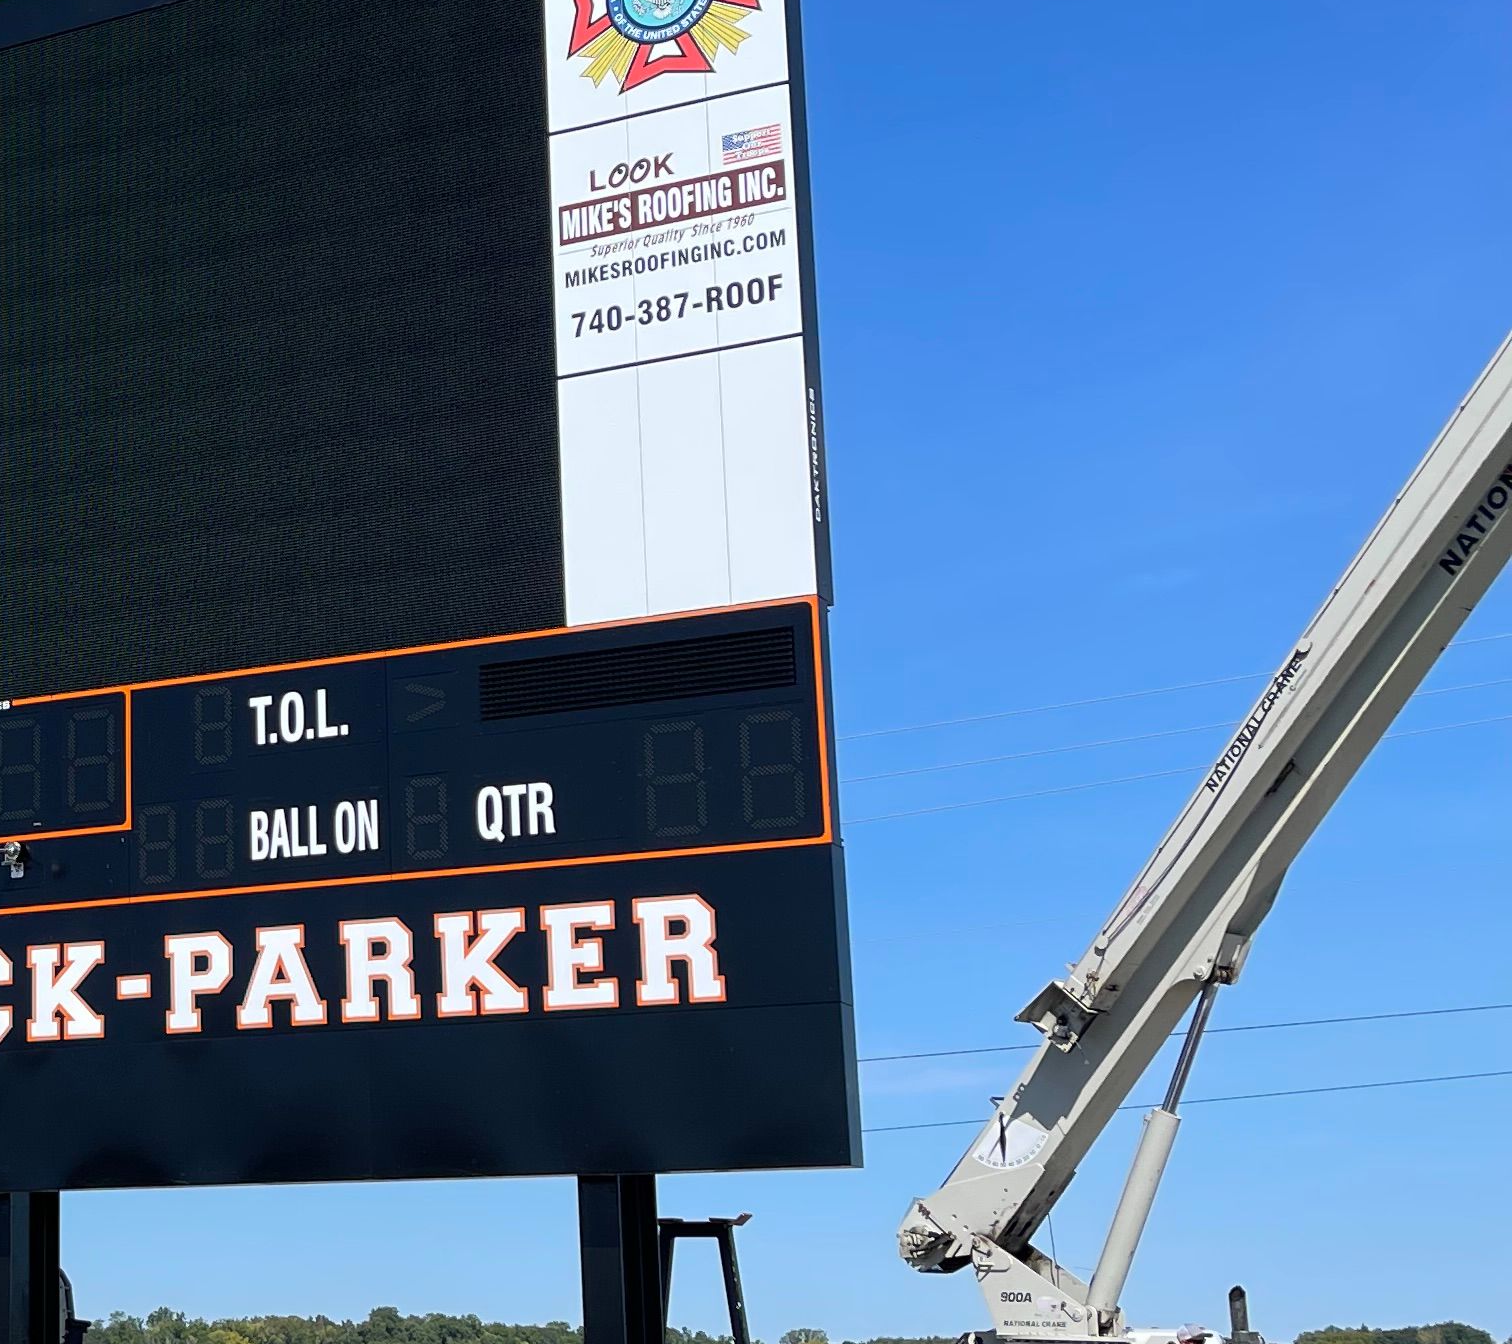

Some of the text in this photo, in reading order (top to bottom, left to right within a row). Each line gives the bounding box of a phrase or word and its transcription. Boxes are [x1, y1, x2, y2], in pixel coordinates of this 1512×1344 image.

[614, 13, 627, 26] OF
[624, 21, 644, 39] THE
[643, 23, 681, 40] UNITED
[590, 152, 675, 192] LOOK
[562, 166, 784, 240] MIKE'S ROOFING INC.
[565, 228, 786, 288] MIKESROOFINGINC.COM
[590, 238, 640, 258] Superior
[643, 227, 686, 247] Quality
[691, 222, 722, 237] Since
[571, 273, 783, 338] 740-387-ROOF
[808, 387, 821, 522] DAKTRONICS
[249, 688, 350, 745] T.O.L.
[1205, 656, 1302, 792] NATIONAL CRANE
[249, 798, 380, 860] BALL ON
[475, 781, 557, 842] QTR
[1000, 1291, 1032, 1303] 900A
